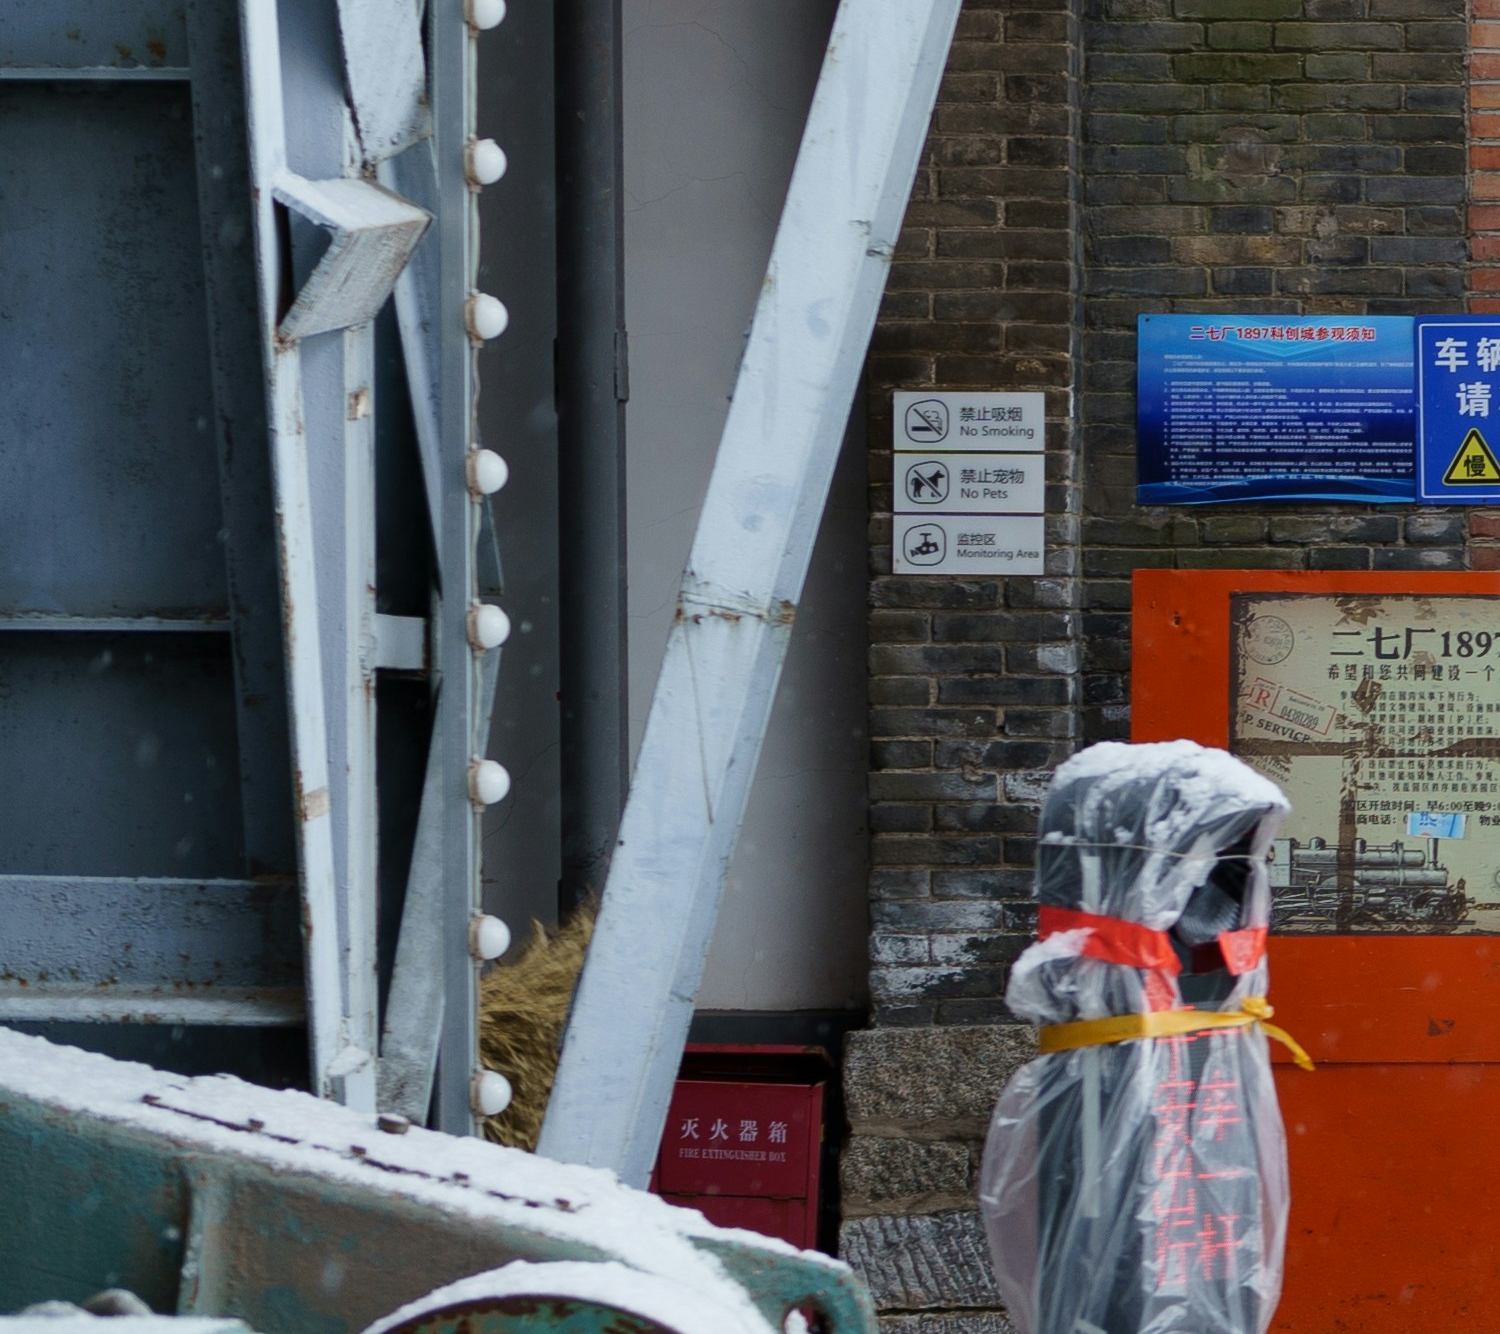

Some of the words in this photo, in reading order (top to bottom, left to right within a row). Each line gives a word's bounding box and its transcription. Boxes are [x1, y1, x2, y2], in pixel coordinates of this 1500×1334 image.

[1189, 326, 1376, 342] 二七厂1897科创城参观须知
[960, 407, 1022, 422] 禁止吸烟
[960, 426, 978, 436] No
[982, 426, 1034, 439] Smoking
[1464, 455, 1486, 477] 慢
[960, 469, 1024, 484] 禁止宠物
[961, 488, 978, 499] No
[983, 488, 1008, 499] Pets
[957, 533, 996, 546] 监控区
[957, 549, 1013, 561] Monitoring
[1016, 550, 1039, 559] Area
[680, 1118, 788, 1144] 灭火器箱
[679, 1148, 700, 1159] FIRE
[702, 1149, 766, 1162] EXTINGUISHER
[768, 1151, 787, 1163] BOX
